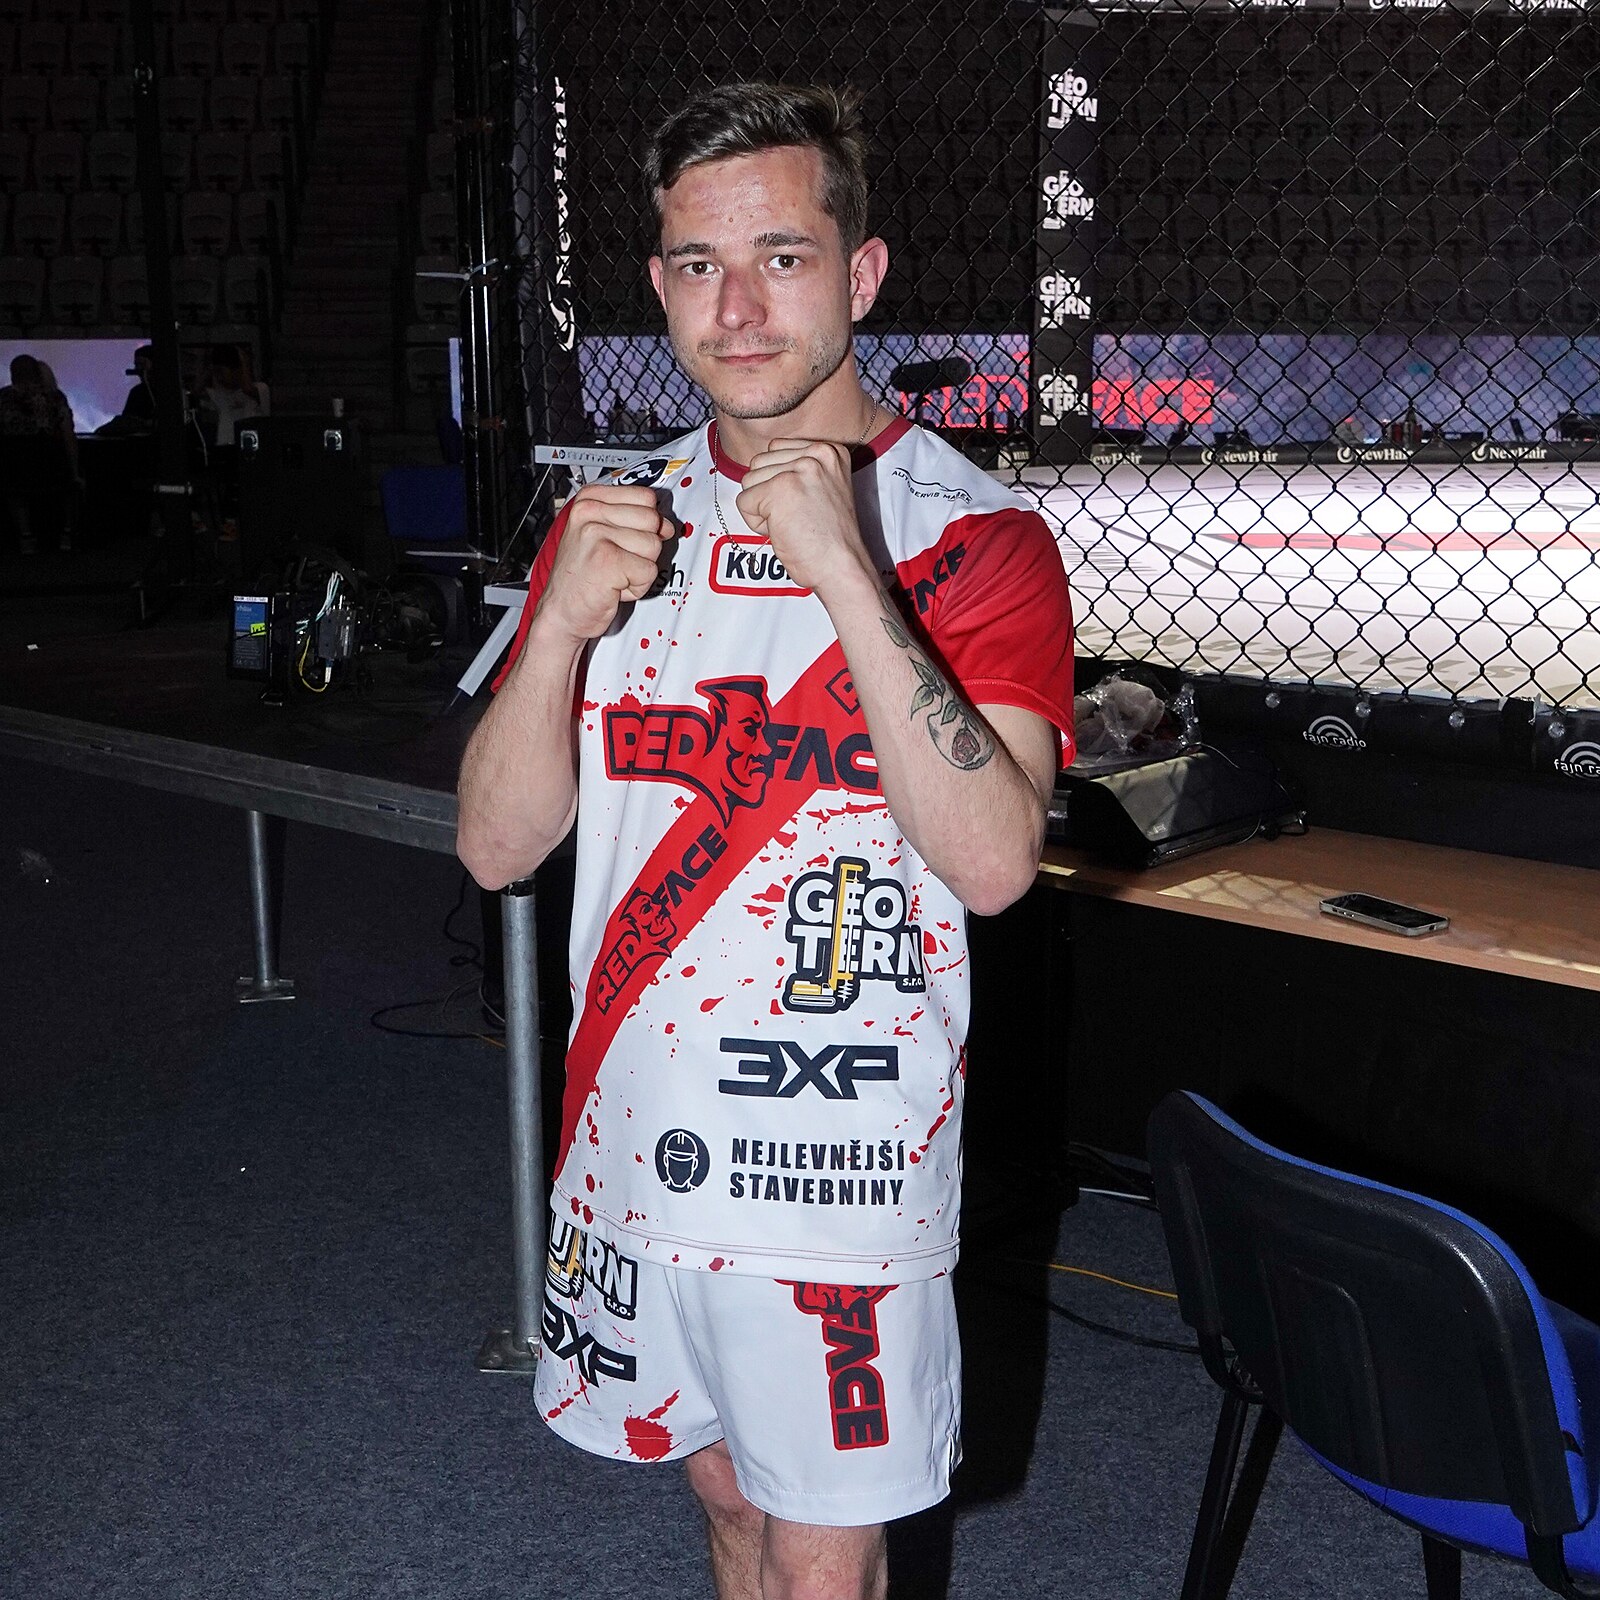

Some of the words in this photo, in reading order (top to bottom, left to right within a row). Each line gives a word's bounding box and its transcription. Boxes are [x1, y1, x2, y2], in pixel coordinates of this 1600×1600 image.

[1039, 275, 1081, 295] GEO
[1039, 294, 1092, 315] TERN
[1354, 448, 1414, 461] NewHair
[1489, 447, 1547, 460] NewHair
[725, 551, 790, 581] KUG
[607, 710, 712, 774] RED
[760, 722, 880, 790] FAC
[1302, 731, 1329, 745] fajn
[1332, 736, 1367, 748] radio
[1554, 758, 1583, 774] fajn
[595, 930, 641, 1015] RED
[651, 823, 729, 917] FACE
[795, 878, 904, 930] GEO
[792, 924, 922, 976] TERN
[731, 1138, 905, 1171] NEJLEVNĚJŠÍ
[729, 1172, 904, 1206] STAVEBNINY
[826, 1297, 884, 1445] FACE
